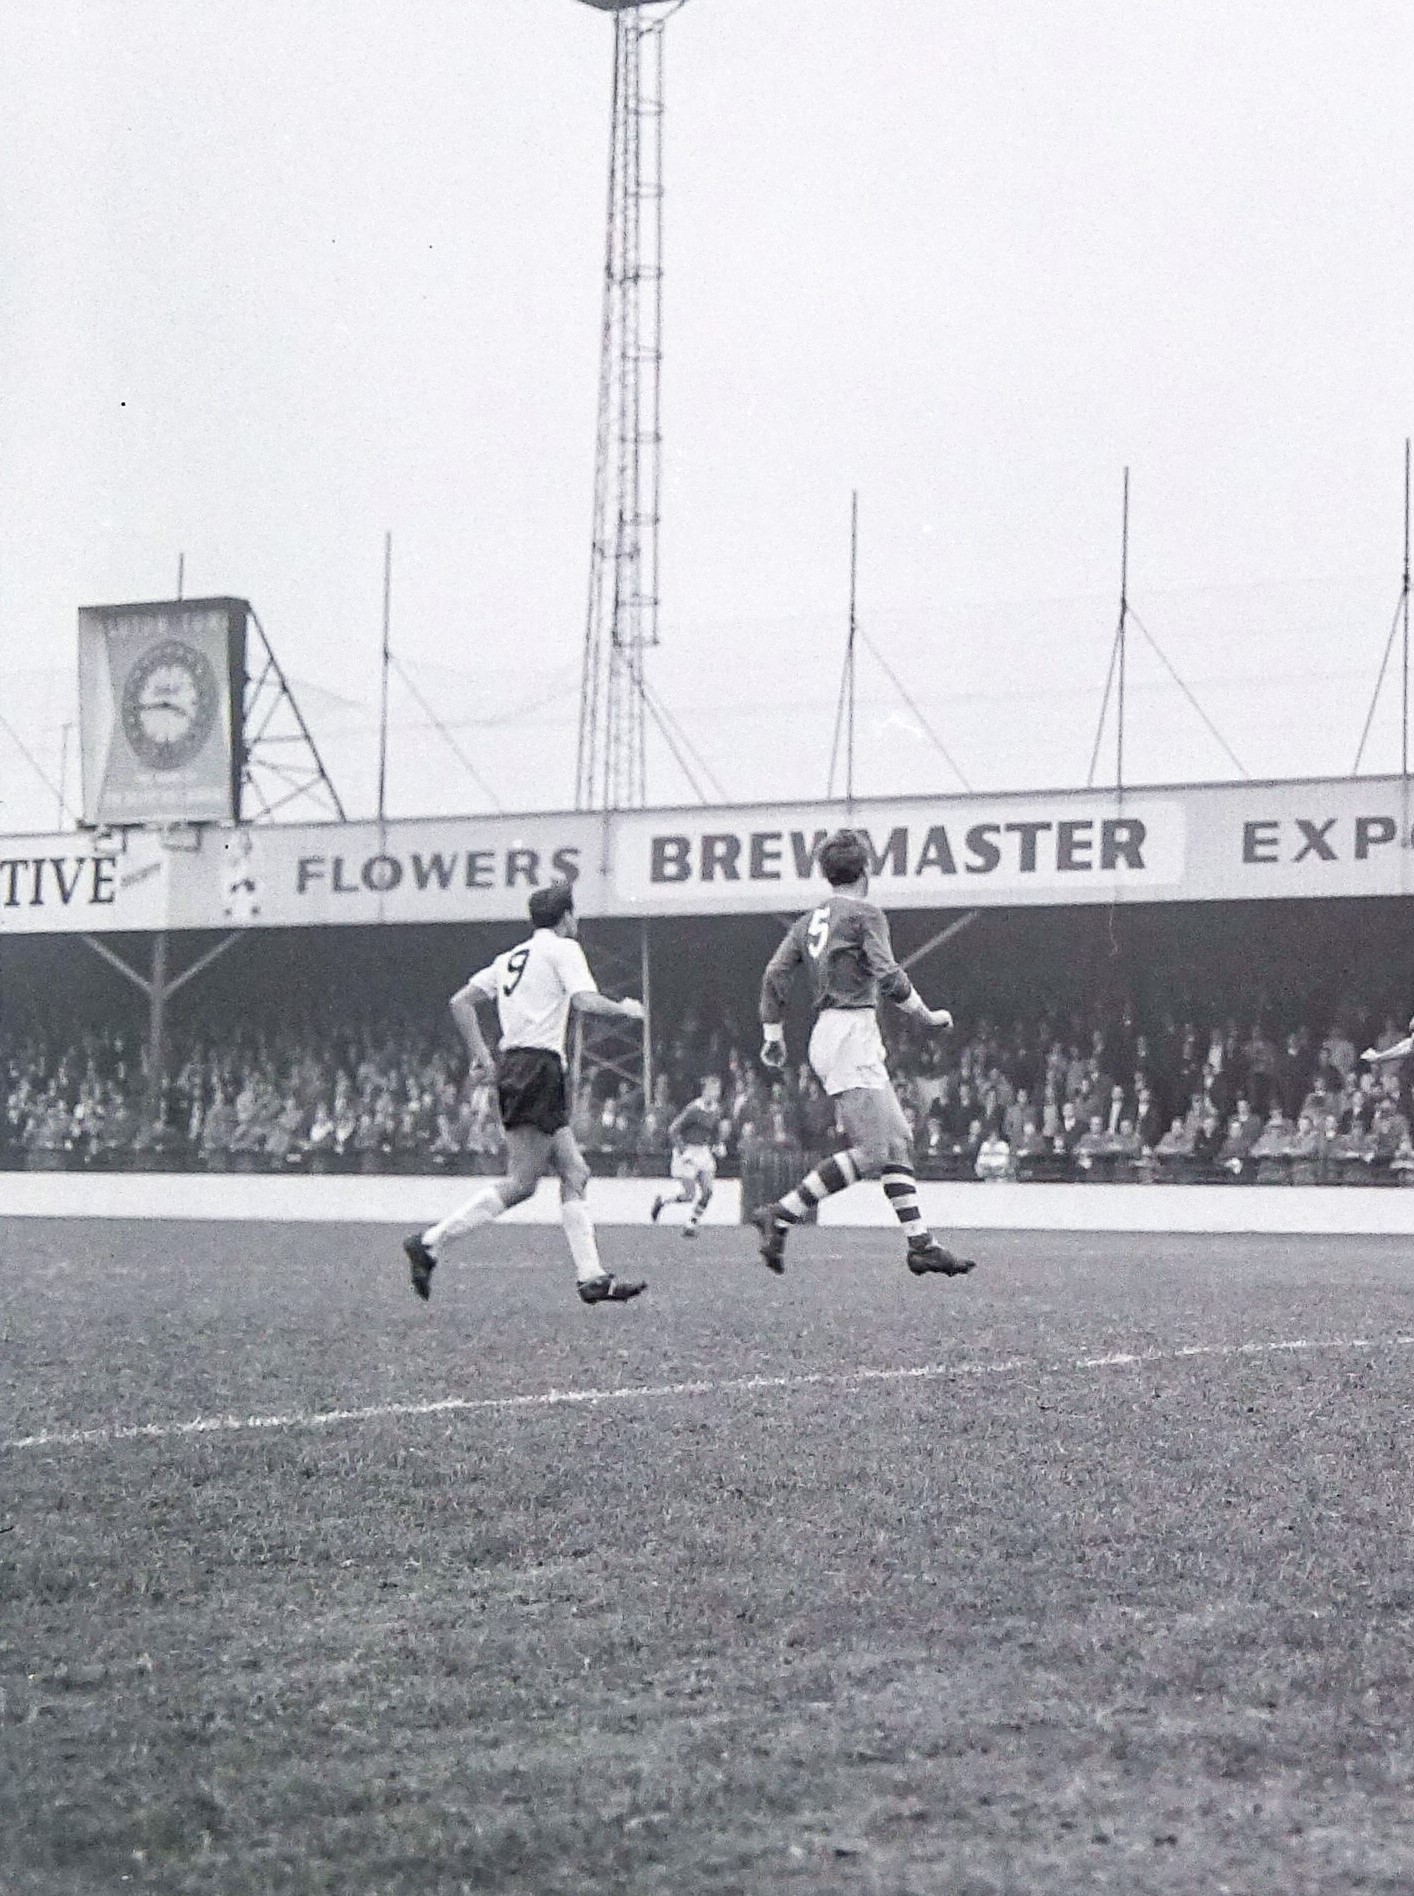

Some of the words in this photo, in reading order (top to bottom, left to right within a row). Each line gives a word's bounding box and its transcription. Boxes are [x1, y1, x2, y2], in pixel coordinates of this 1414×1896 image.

[0, 856, 117, 907] TIVE
[296, 846, 580, 895] FLOWERS
[650, 818, 1149, 884] BREWMASTER
[808, 904, 831, 959] 5
[502, 949, 530, 998] 9
